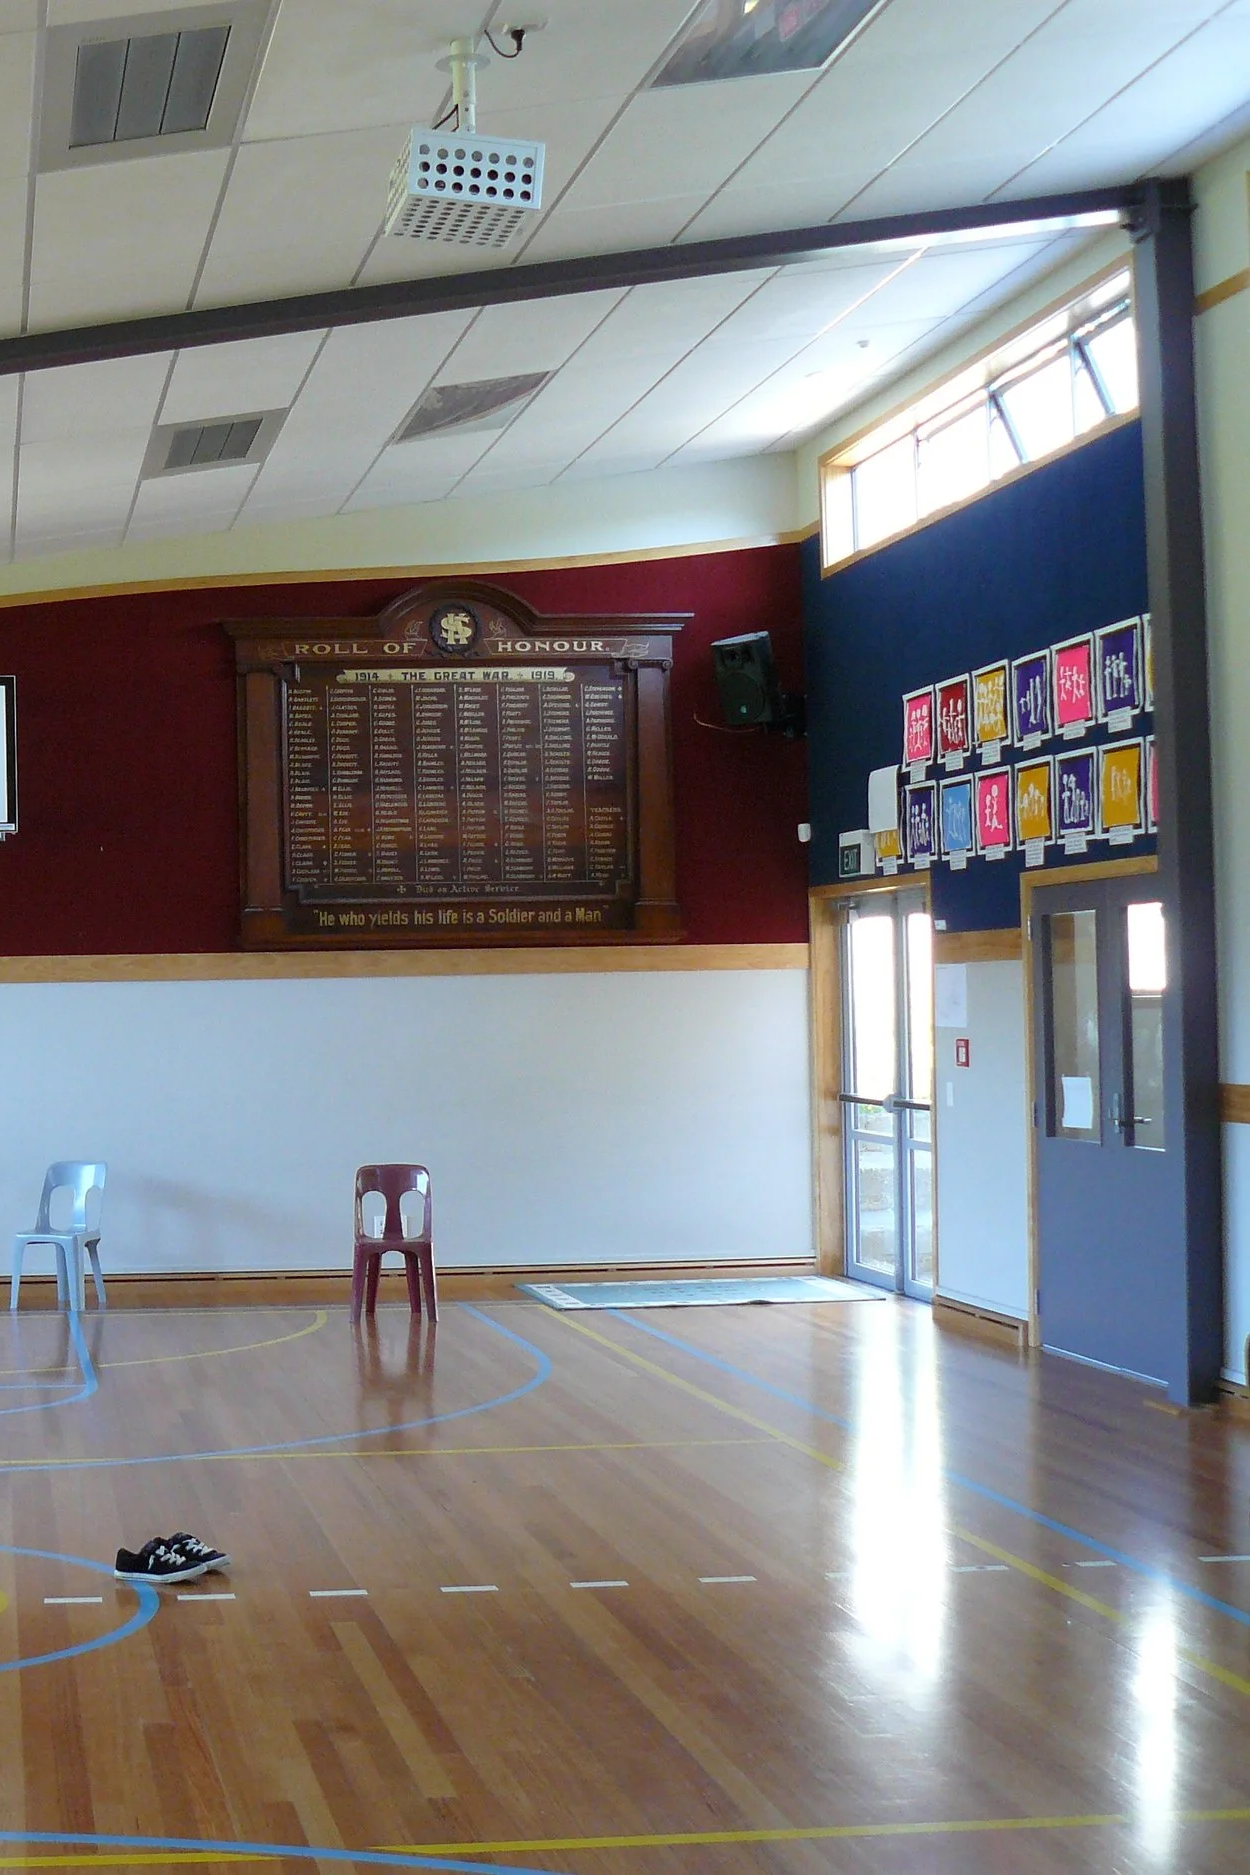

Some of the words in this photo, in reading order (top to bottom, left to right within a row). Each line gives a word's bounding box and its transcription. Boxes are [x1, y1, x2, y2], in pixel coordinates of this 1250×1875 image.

[295, 645, 367, 654] ROLL
[384, 643, 417, 653] OF
[401, 671, 426, 680] THE
[433, 671, 475, 681] GREAT
[844, 848, 858, 871] EXIT
[450, 883, 479, 892] Active
[485, 881, 519, 891] Service
[339, 911, 366, 926] who
[369, 909, 409, 929] yields
[414, 909, 434, 924] his
[438, 908, 459, 924] life
[463, 909, 474, 924] is
[476, 913, 486, 923] a
[488, 907, 536, 923] Soldier
[538, 908, 562, 923] and
[565, 911, 573, 922] a
